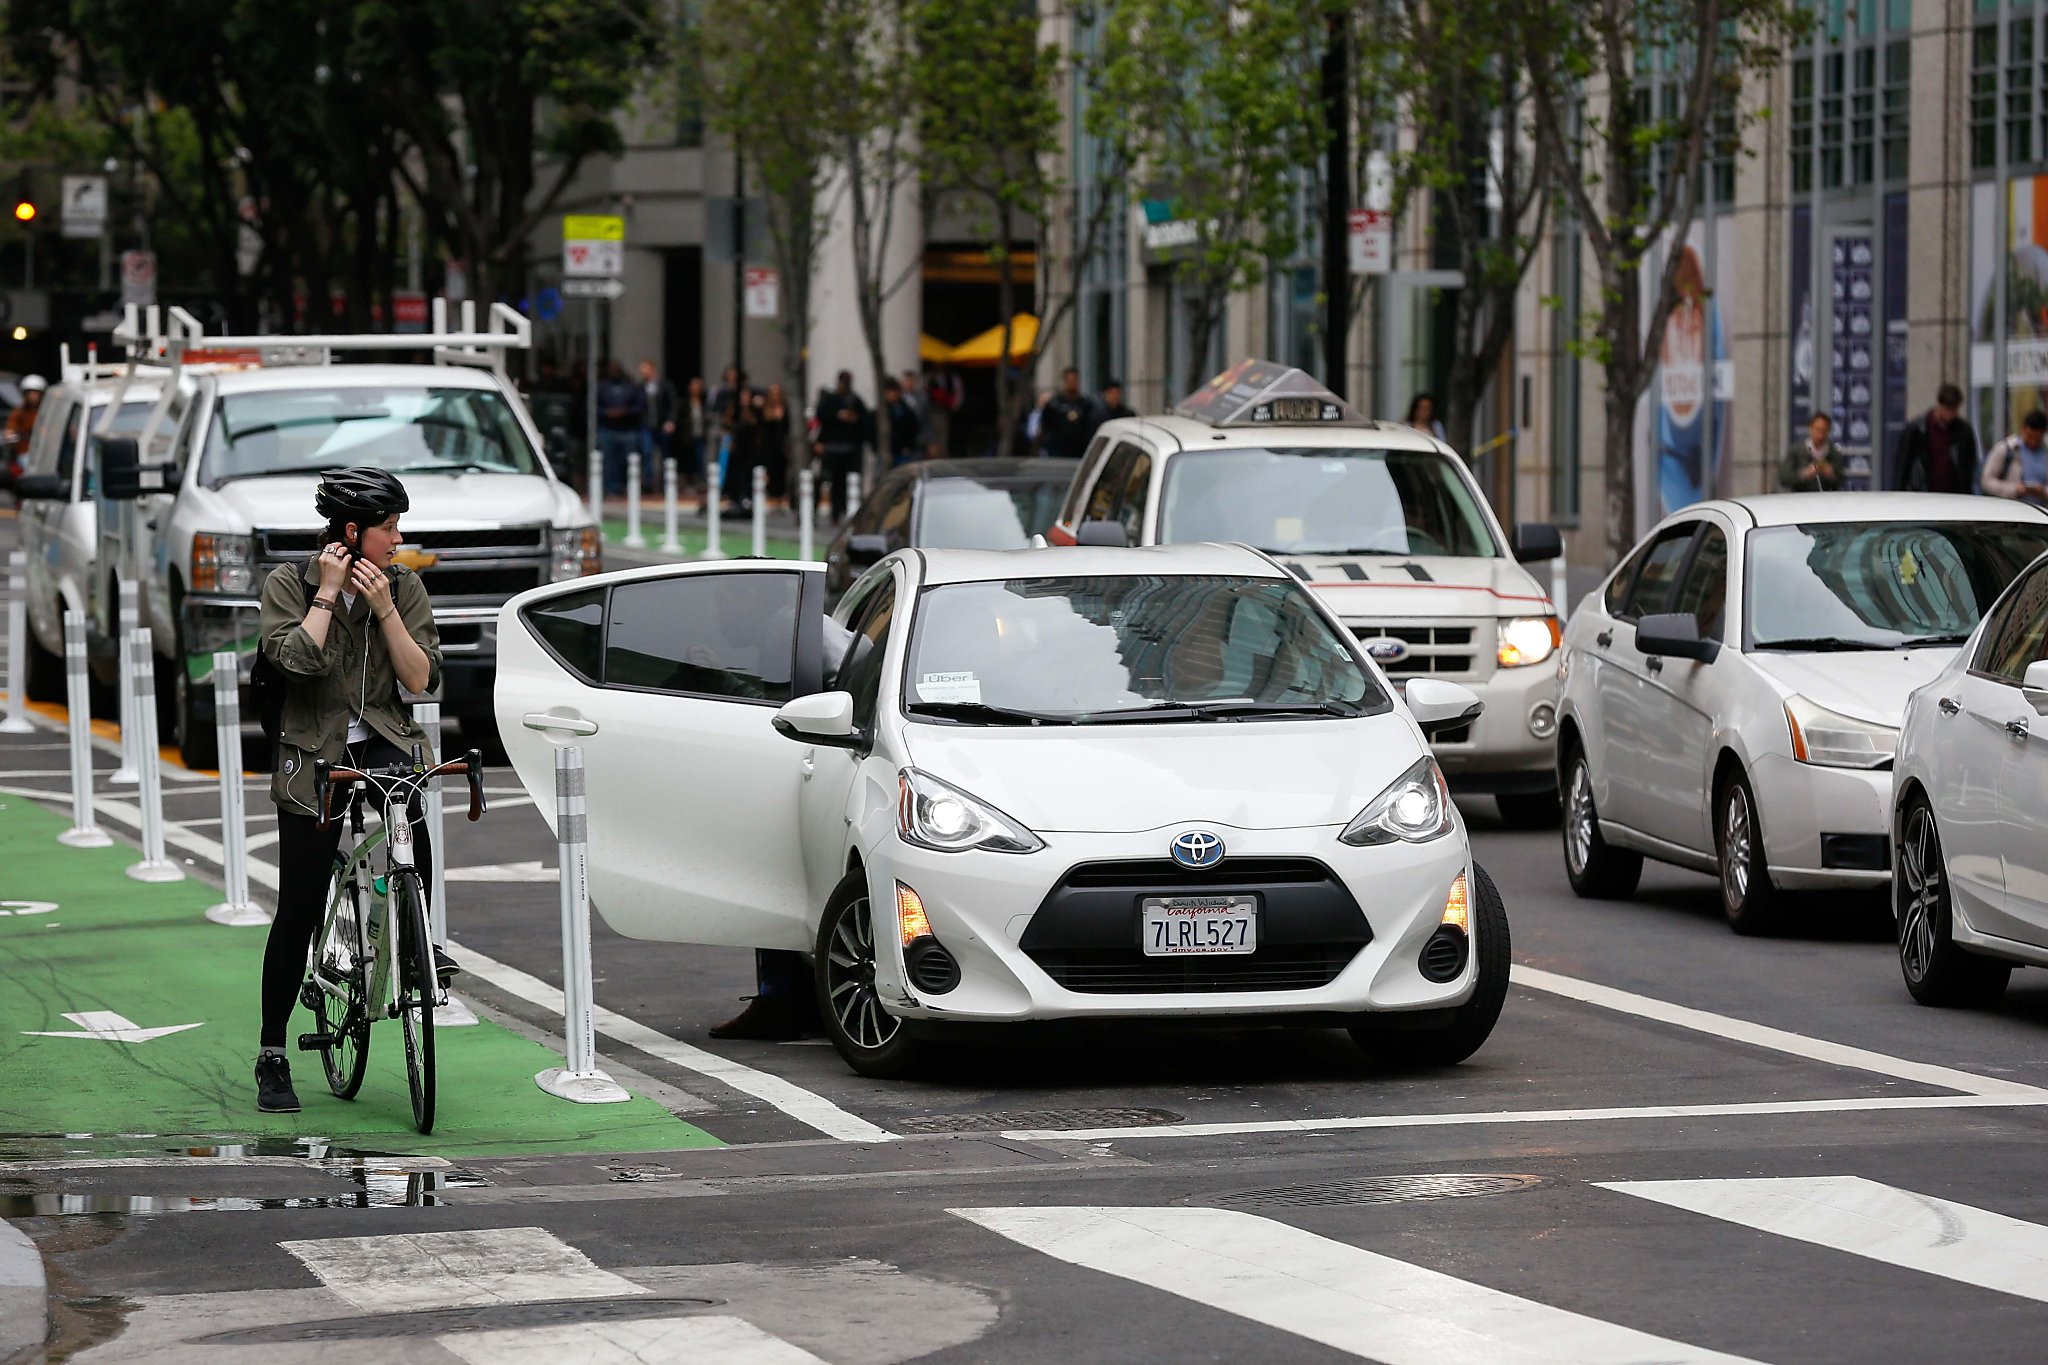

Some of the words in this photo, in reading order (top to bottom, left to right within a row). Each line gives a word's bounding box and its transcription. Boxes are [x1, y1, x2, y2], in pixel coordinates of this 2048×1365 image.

[340, 487, 357, 497] GIRO
[1167, 907, 1235, 919] California
[1151, 919, 1248, 947] 7LRL527
